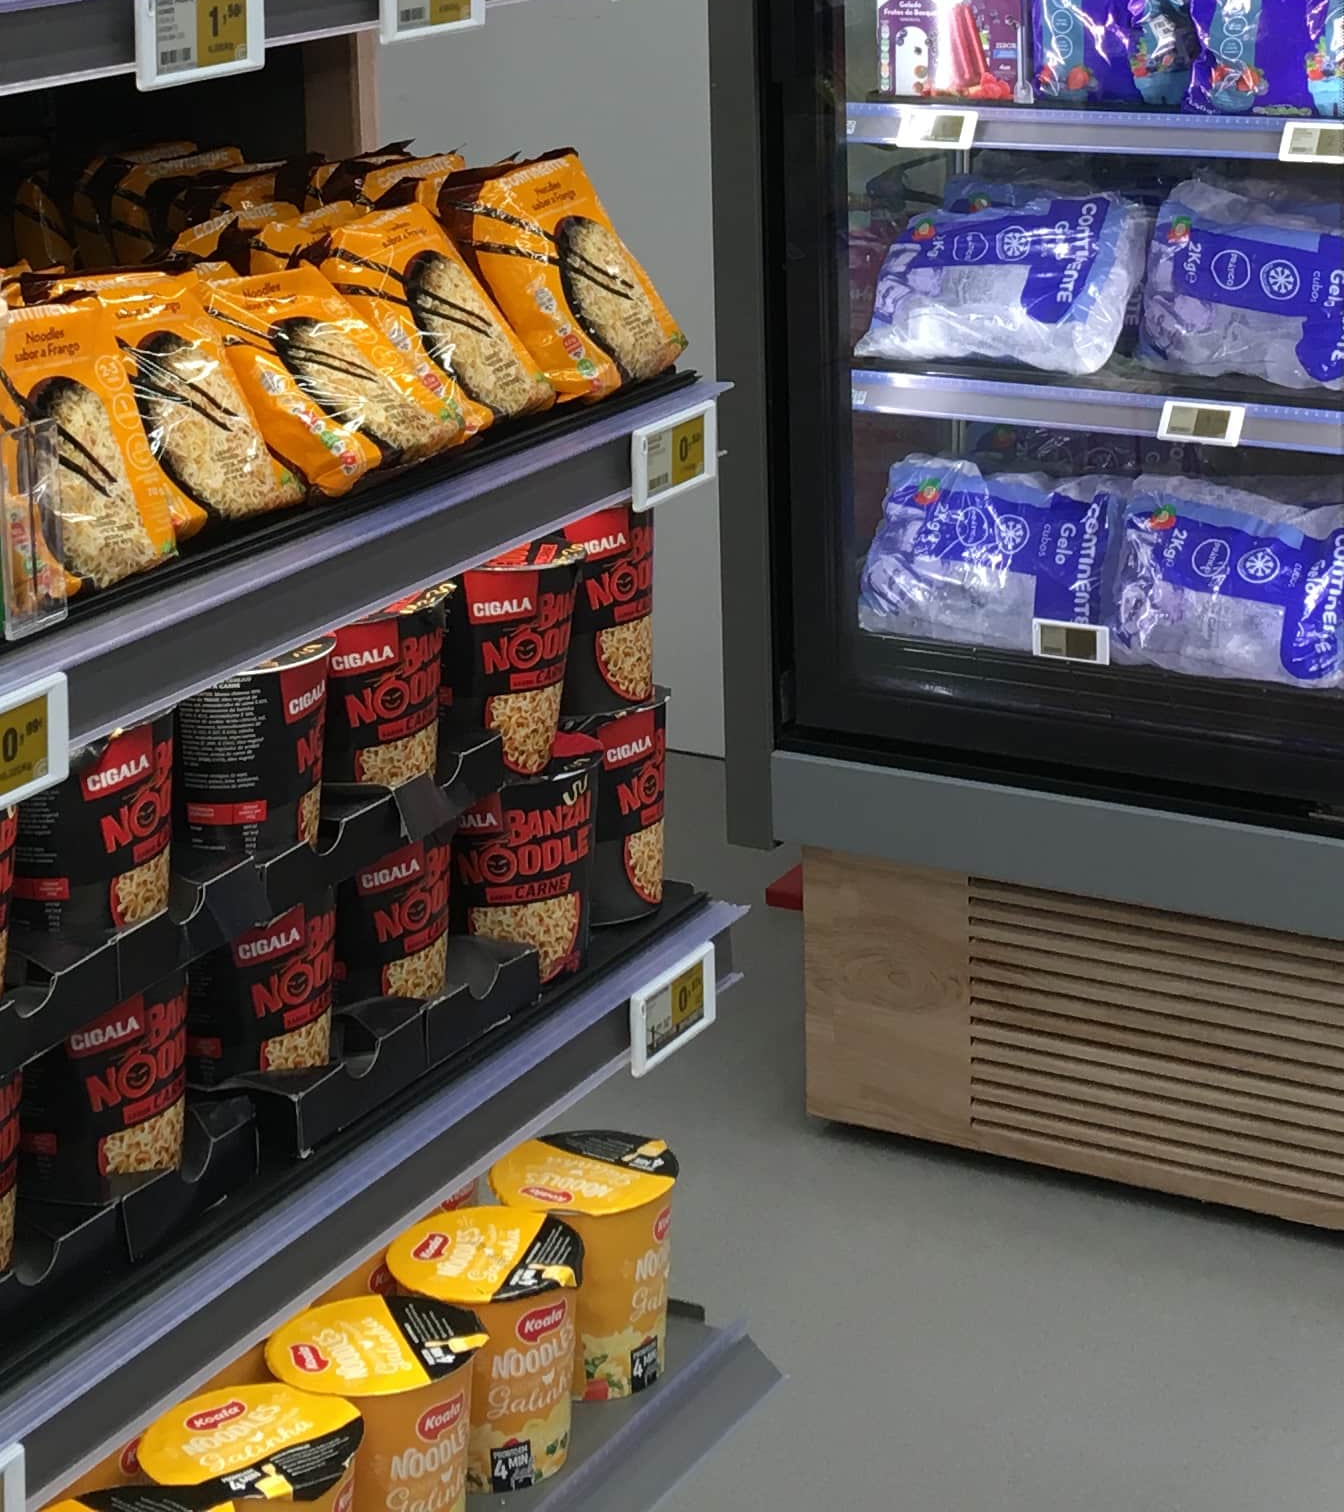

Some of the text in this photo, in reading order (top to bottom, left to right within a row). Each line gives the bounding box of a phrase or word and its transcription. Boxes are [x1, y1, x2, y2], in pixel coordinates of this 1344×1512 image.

[25, 329, 64, 343] Noodles
[1056, 522, 1077, 565] Gelo
[473, 597, 532, 617] CIGALA
[332, 645, 394, 670] CIGALA
[607, 736, 652, 762] CIGALA
[87, 757, 150, 792] CIGALA
[508, 791, 591, 839] BANZAI
[362, 859, 420, 888] CIGALA
[238, 928, 300, 960] CIGALA
[71, 1017, 139, 1051] CIGALA
[524, 1306, 565, 1334] Koala
[194, 1406, 241, 1428] Koala
[424, 1403, 462, 1431] Koala
[494, 1450, 529, 1480] 4 MIN
